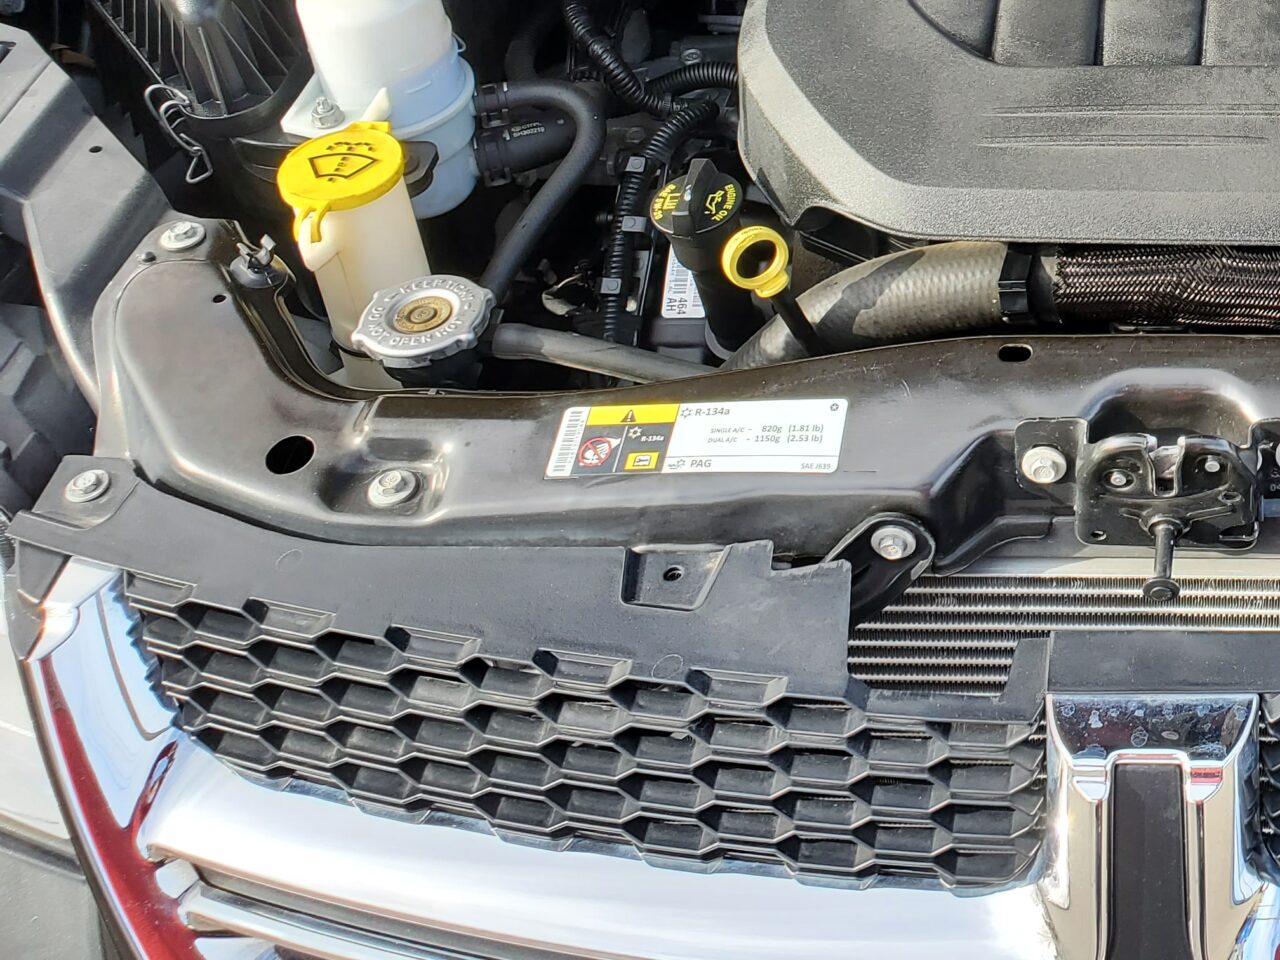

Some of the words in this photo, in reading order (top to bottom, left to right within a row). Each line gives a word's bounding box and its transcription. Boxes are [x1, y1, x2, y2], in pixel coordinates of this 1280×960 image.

[722, 183, 737, 211] ENGINE
[709, 209, 729, 222] OIL
[367, 306, 385, 321] DO
[389, 333, 432, 346] OPEN
[435, 317, 463, 338] HOT
[694, 407, 731, 417] R-134a
[732, 426, 745, 434] A/C
[761, 425, 783, 434] 820g
[788, 424, 810, 433] (1.81
[811, 424, 824, 433] lb)
[707, 436, 724, 444] DUAL
[725, 436, 738, 444] A/C
[754, 435, 781, 444] 1150g
[787, 434, 809, 444] (2.53
[810, 434, 823, 443] lb)
[690, 459, 713, 469] PAG
[800, 462, 814, 470] SAE
